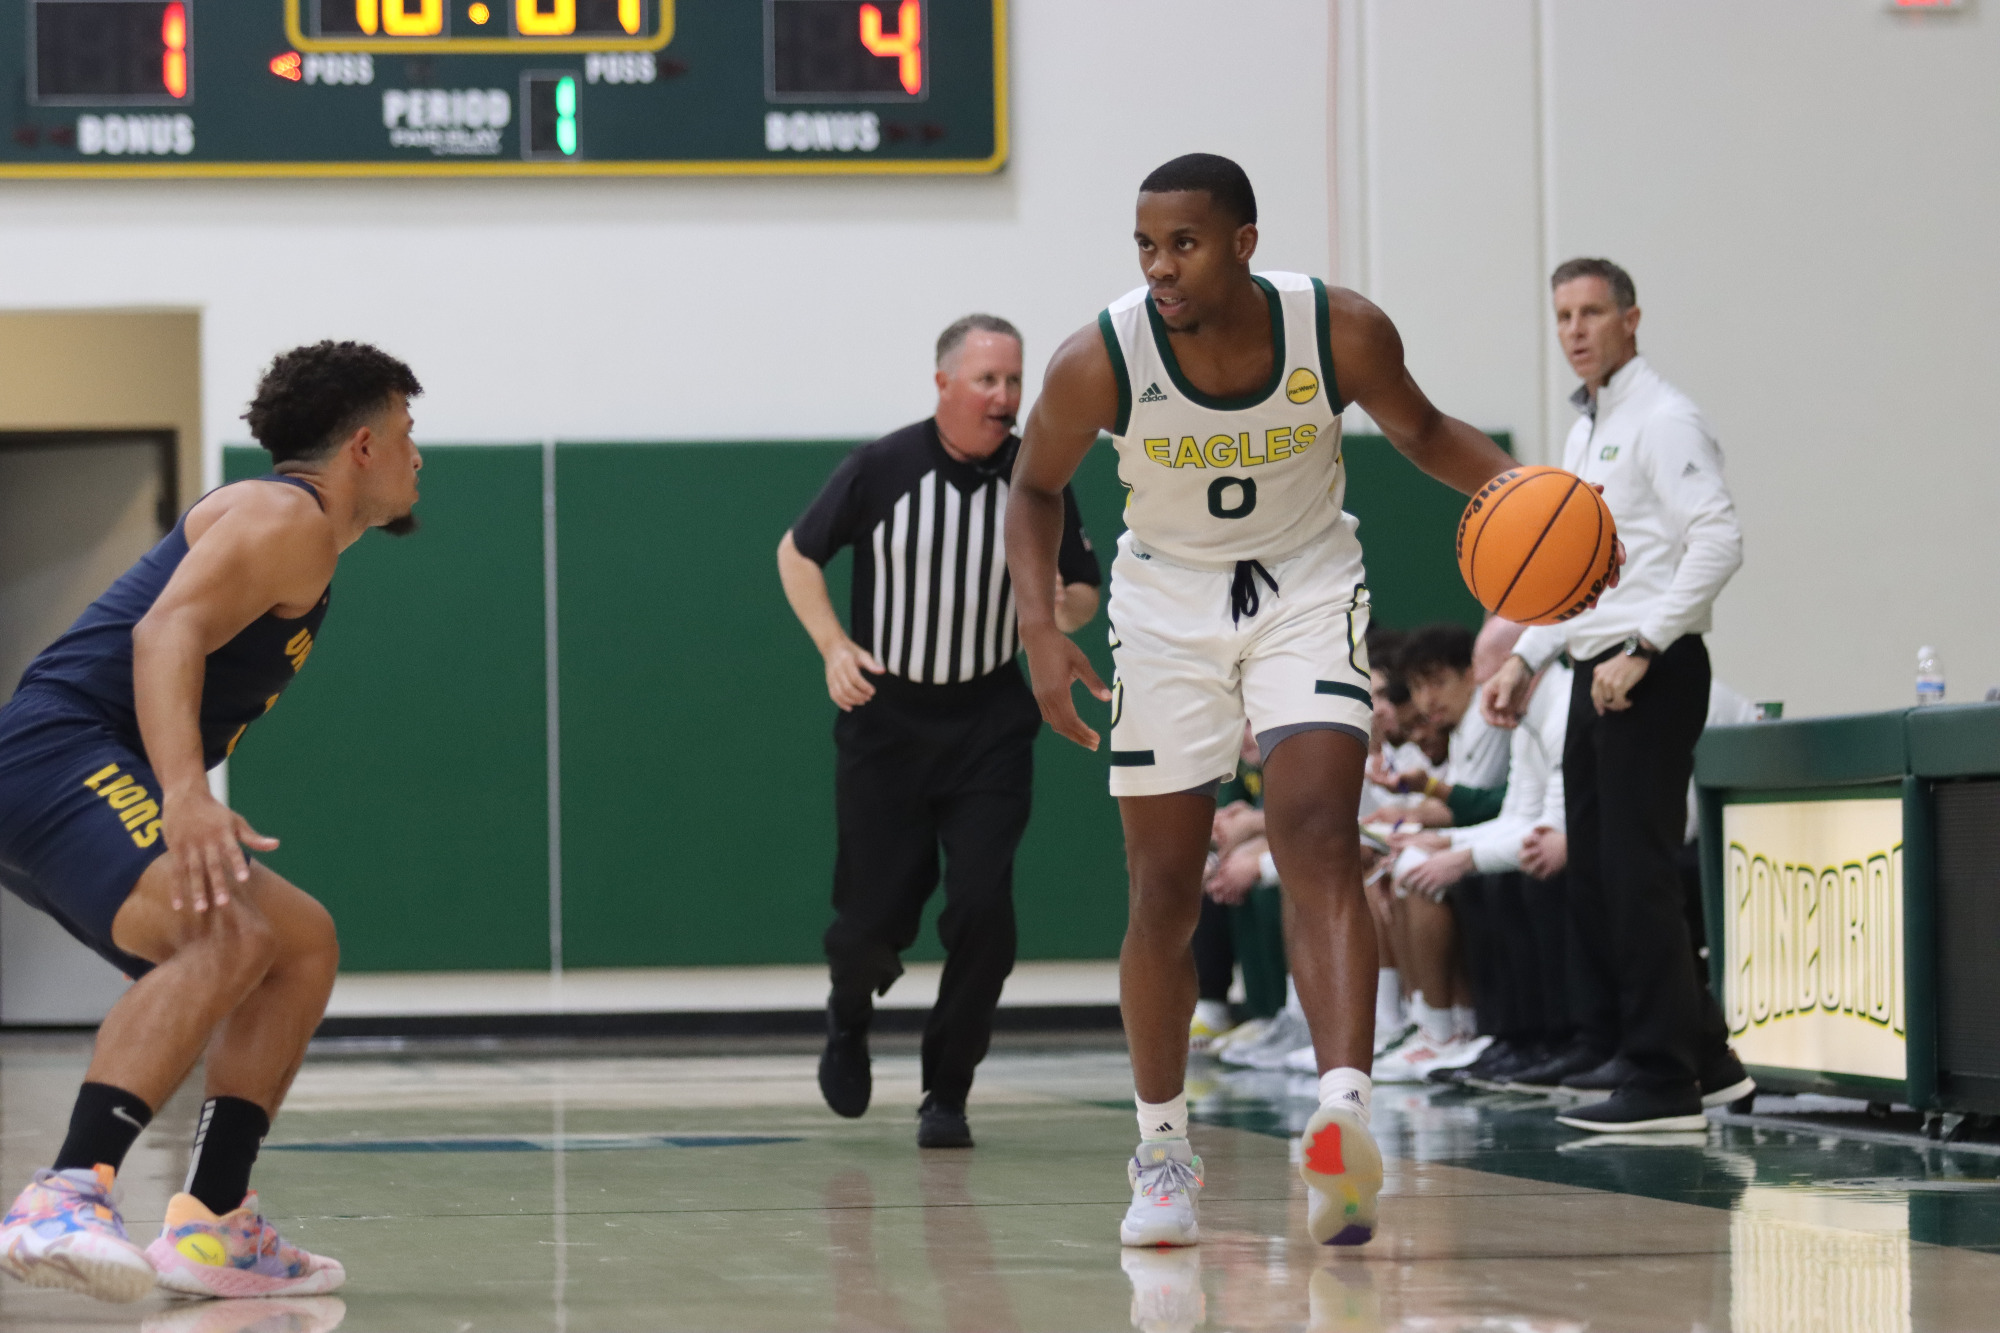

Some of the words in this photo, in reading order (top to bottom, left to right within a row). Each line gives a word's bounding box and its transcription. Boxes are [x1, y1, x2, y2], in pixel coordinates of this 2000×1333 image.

[859, 0, 921, 94] 4
[383, 89, 511, 129] PERIOD
[556, 76, 577, 155] 1
[77, 115, 195, 155] BONUS
[764, 112, 880, 151] BONUS
[1138, 394, 1168, 403] adidas
[1143, 423, 1318, 469] EAGLES
[83, 763, 164, 848] LIONS
